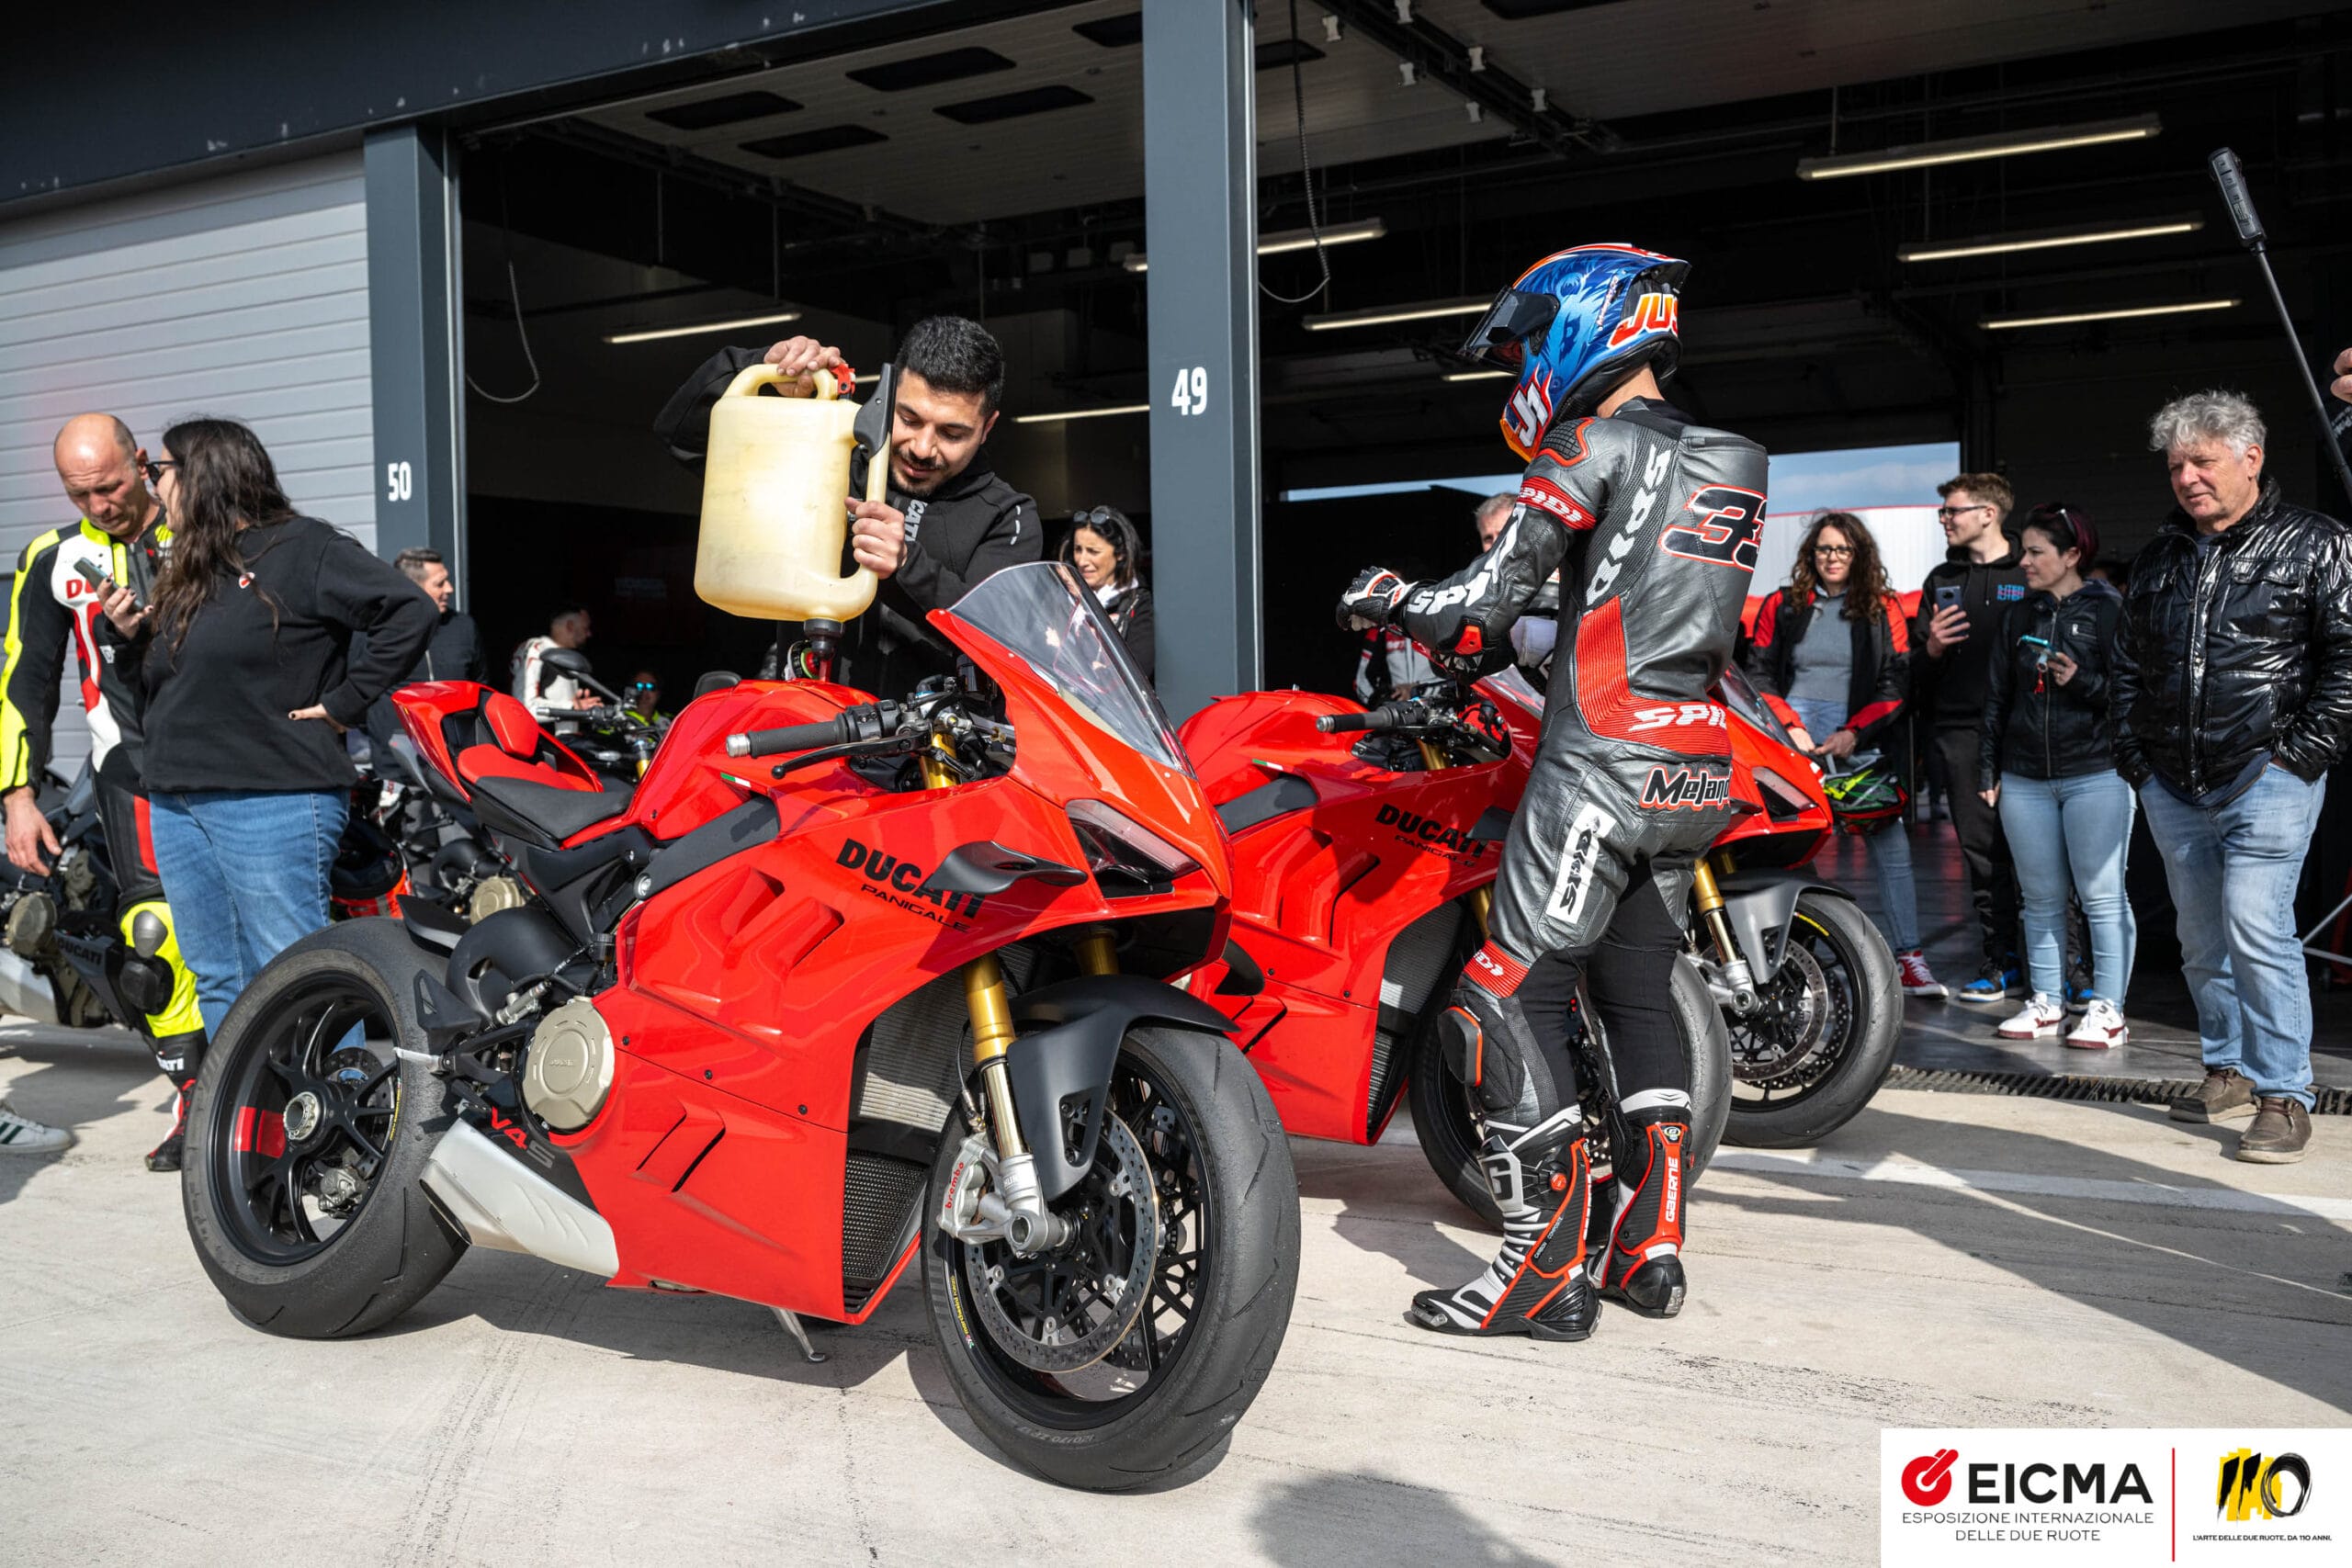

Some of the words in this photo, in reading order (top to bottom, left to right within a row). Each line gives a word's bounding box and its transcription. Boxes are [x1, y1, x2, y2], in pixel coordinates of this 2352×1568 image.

[1171, 367, 1207, 416] 49
[388, 461, 412, 502] 50
[1375, 803, 1488, 858] DUCATI
[1395, 834, 1476, 868] PANIGALE
[836, 837, 986, 919] DUCATI
[860, 883, 971, 933] PANIGALE
[944, 1161, 965, 1210] brembo
